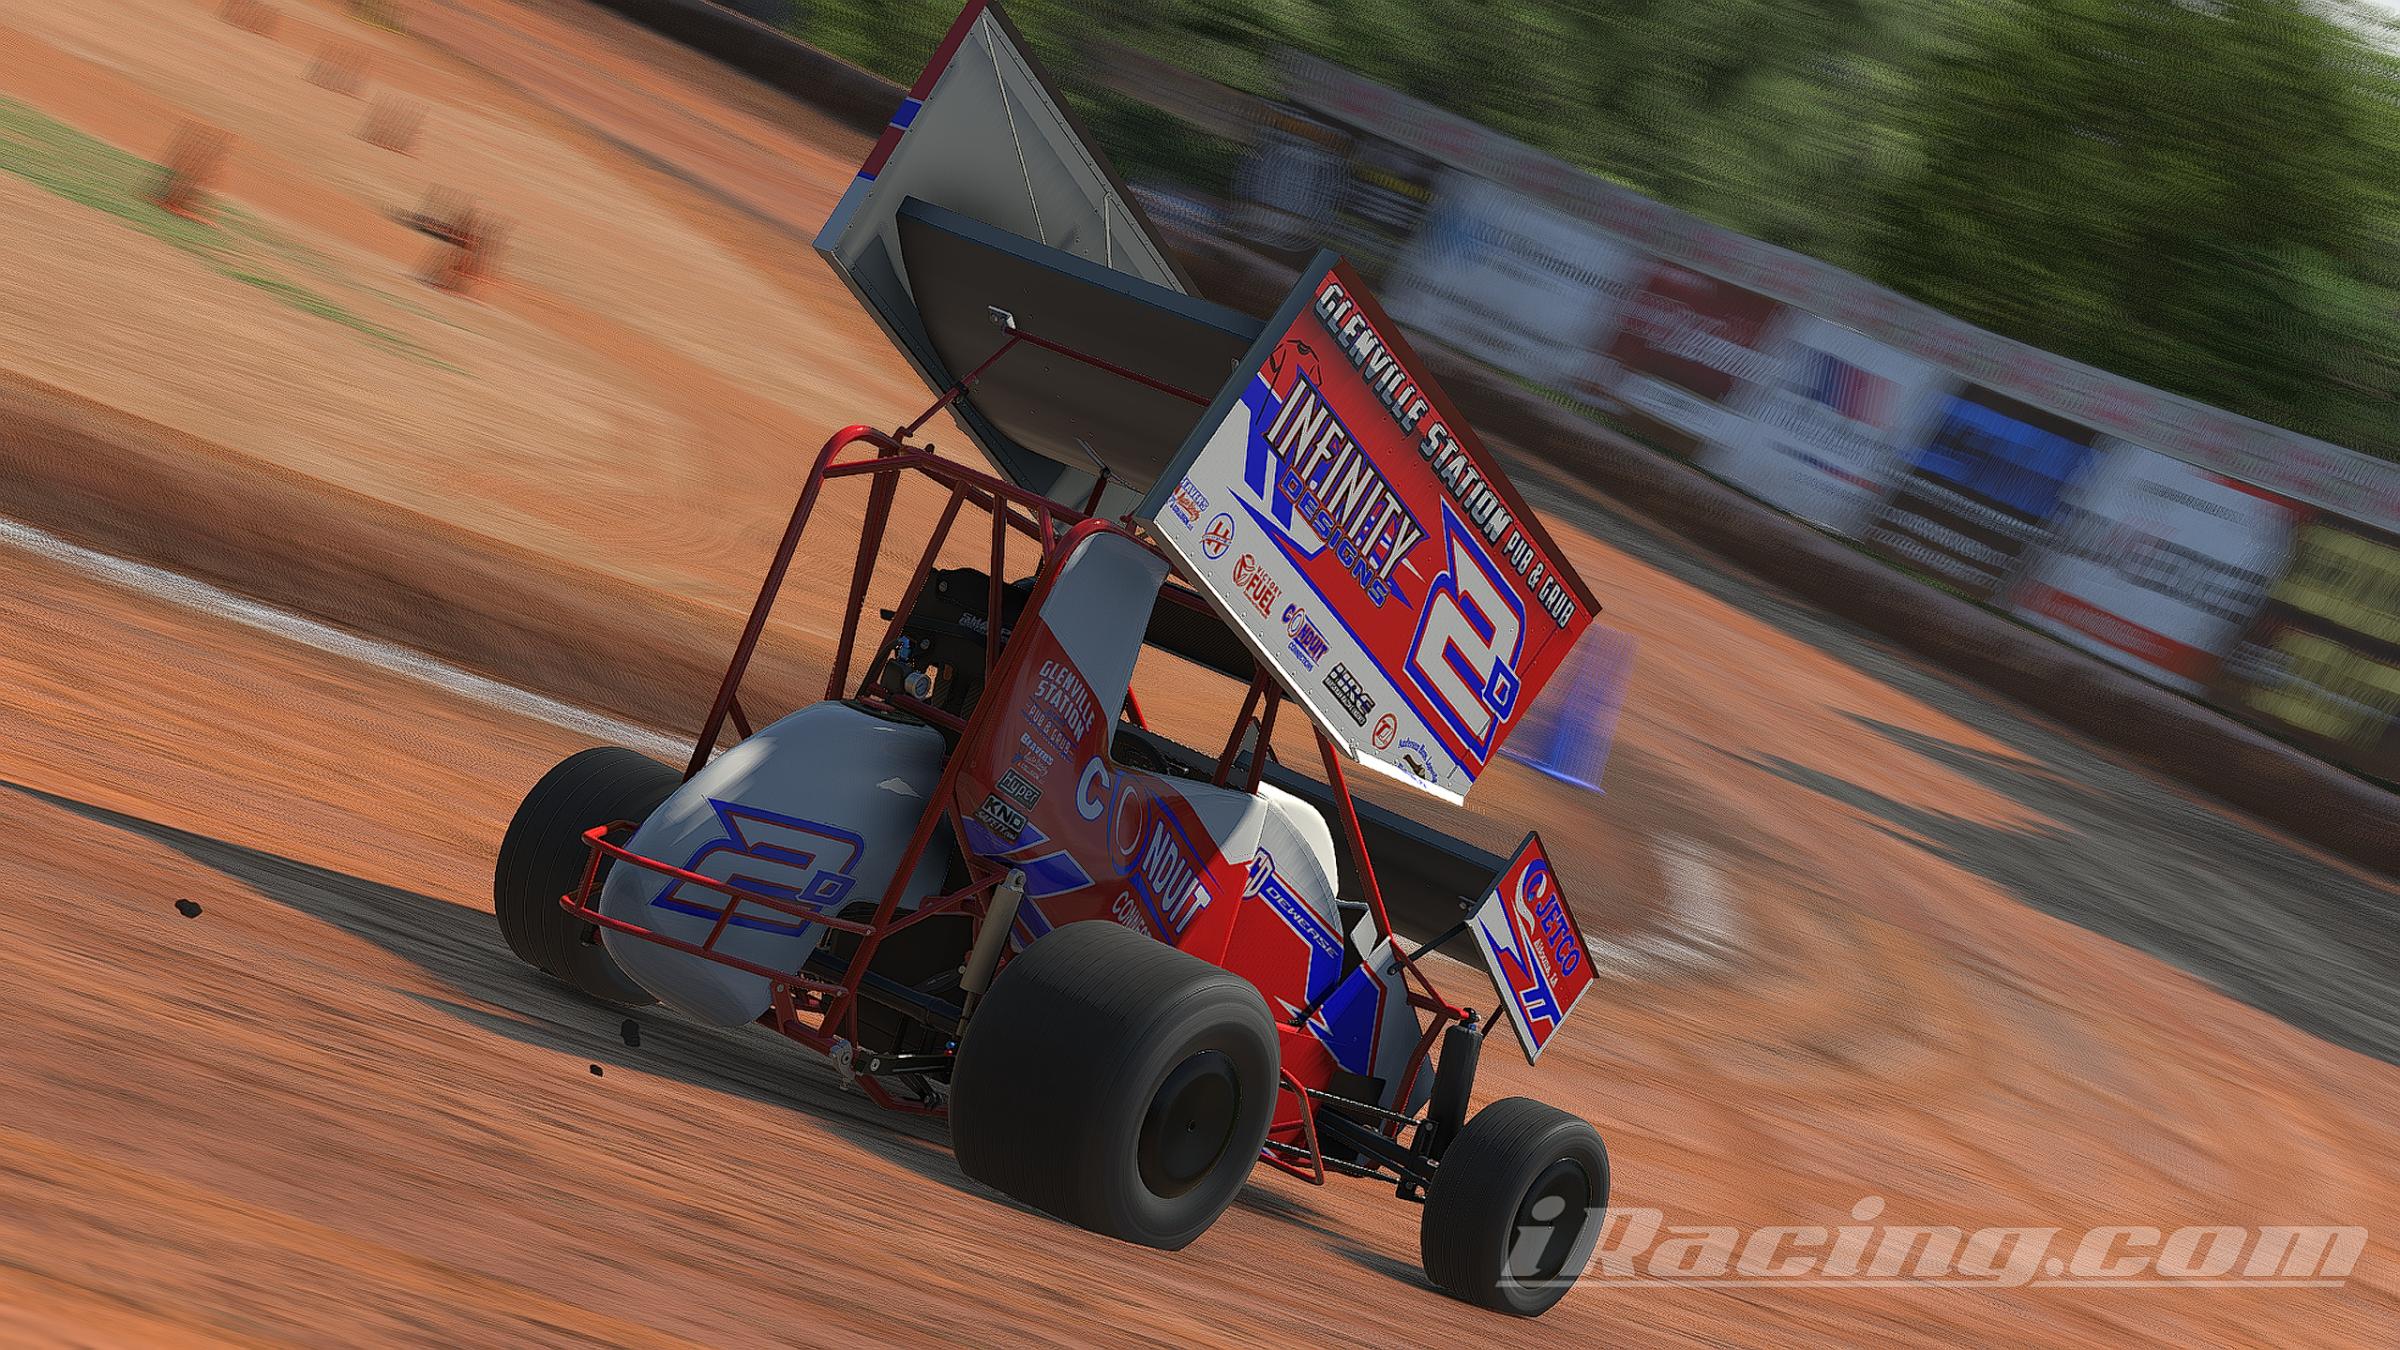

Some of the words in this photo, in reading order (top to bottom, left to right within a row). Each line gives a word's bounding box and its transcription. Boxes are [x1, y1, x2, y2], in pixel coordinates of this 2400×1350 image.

[1263, 376, 1425, 581] INFINITY
[1314, 283, 1429, 435] GLENVILLE
[1418, 421, 1514, 546] STATION
[1502, 530, 1536, 576] PUB
[1526, 562, 1546, 592] &
[1537, 575, 1576, 629] GRUB
[1279, 466, 1390, 608] DESIGNS
[1245, 573, 1276, 616] FUEL
[1258, 564, 1282, 598] VICTORY
[1282, 603, 1329, 663] CONDUIT
[1035, 679, 1085, 742] STATION
[1039, 659, 1095, 732] GLENVILLE
[1000, 770, 1039, 803] Hyper
[1076, 755, 1212, 935] CONDUIT
[1265, 886, 1339, 960] DEWEASE
[1535, 892, 1580, 977] JETCO
